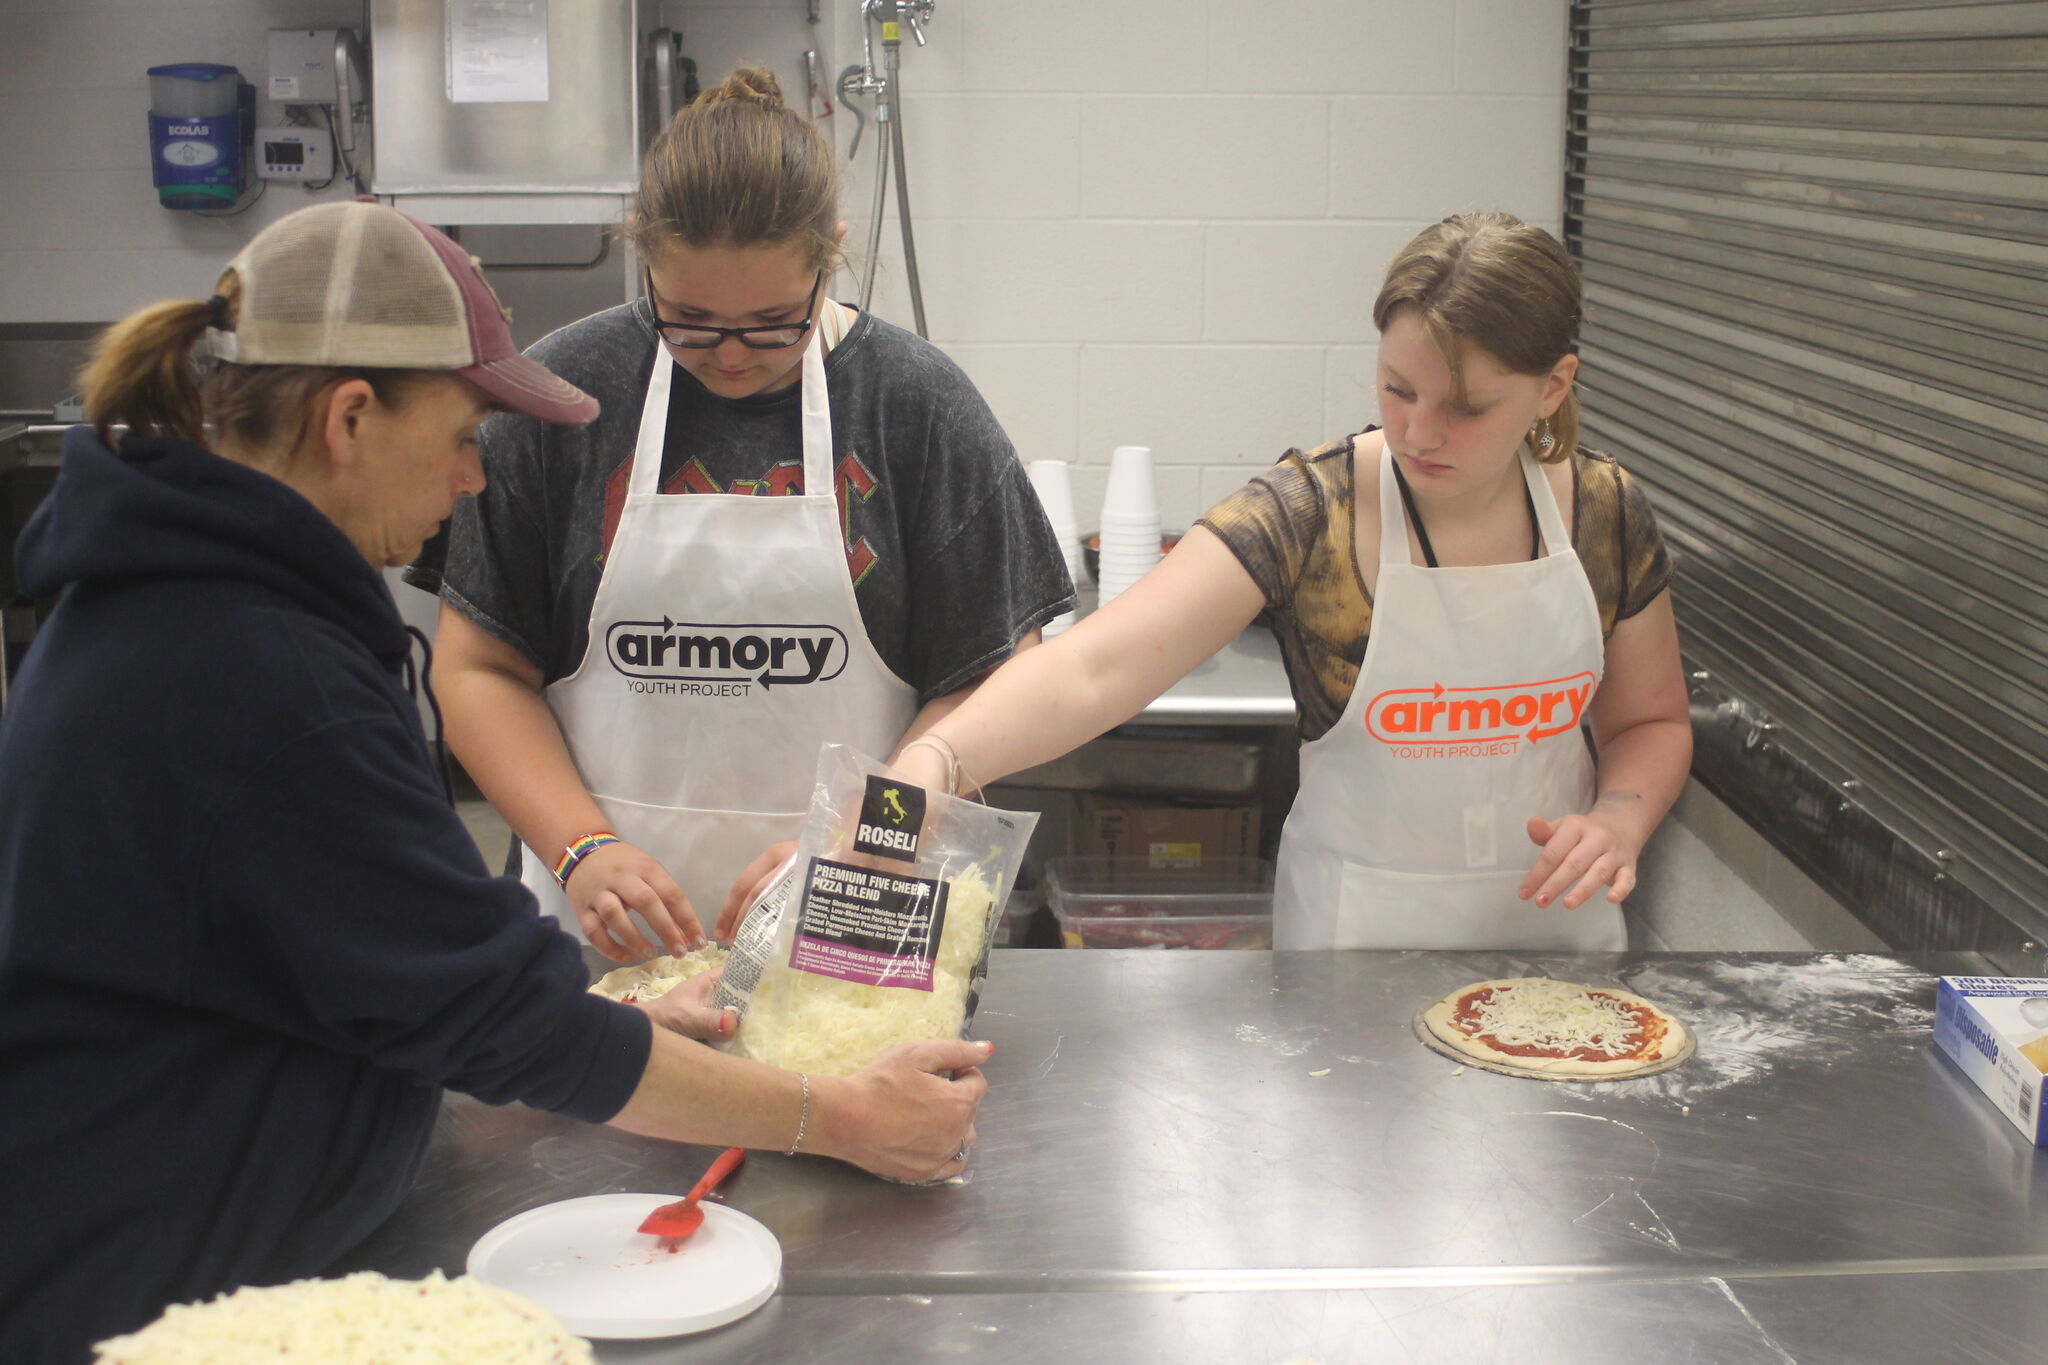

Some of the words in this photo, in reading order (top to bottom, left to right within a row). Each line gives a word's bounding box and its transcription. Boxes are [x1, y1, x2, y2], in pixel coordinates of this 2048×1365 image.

[168, 125, 209, 136] ECOLAB
[616, 633, 835, 685] armory
[627, 680, 676, 694] YOUTH
[681, 684, 752, 697] PROJECT
[1380, 682, 1592, 733] armory
[1390, 746, 1444, 759] YOUTH
[1449, 742, 1521, 758] PROJECT
[858, 824, 918, 852] ROSELI
[812, 877, 843, 894] PIZZA
[845, 884, 880, 901] BLEND
[814, 864, 868, 886] PREMIUM
[869, 875, 891, 891] FIVE
[808, 893, 831, 905] Feather
[832, 899, 860, 911] Shredded
[860, 905, 897, 918] Low-Moisture
[831, 906, 871, 920] Low-Moisture
[803, 923, 825, 934] Cheese
[825, 928, 843, 937] Blend
[805, 915, 825, 926] Grated
[825, 920, 854, 933] Parmesan
[854, 926, 875, 938] Cheese
[830, 914, 860, 926] Unsmoked
[861, 920, 887, 931] Provolone
[1954, 1003, 1999, 1065] Disposable
